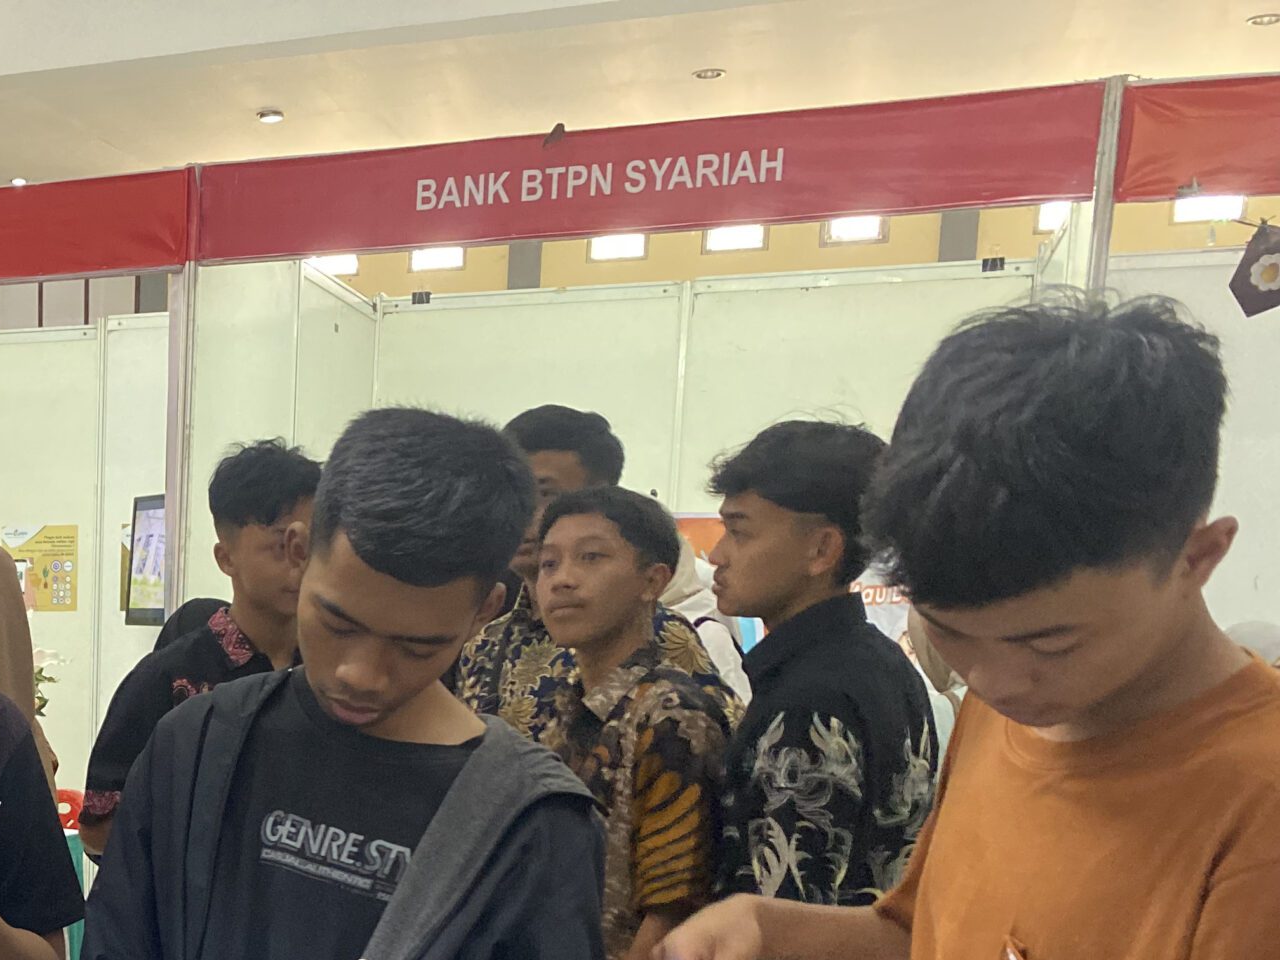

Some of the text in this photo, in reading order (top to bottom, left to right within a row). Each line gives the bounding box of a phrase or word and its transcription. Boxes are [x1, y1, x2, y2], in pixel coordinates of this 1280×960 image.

[416, 147, 784, 211] BANK BTPN SYARIAH
